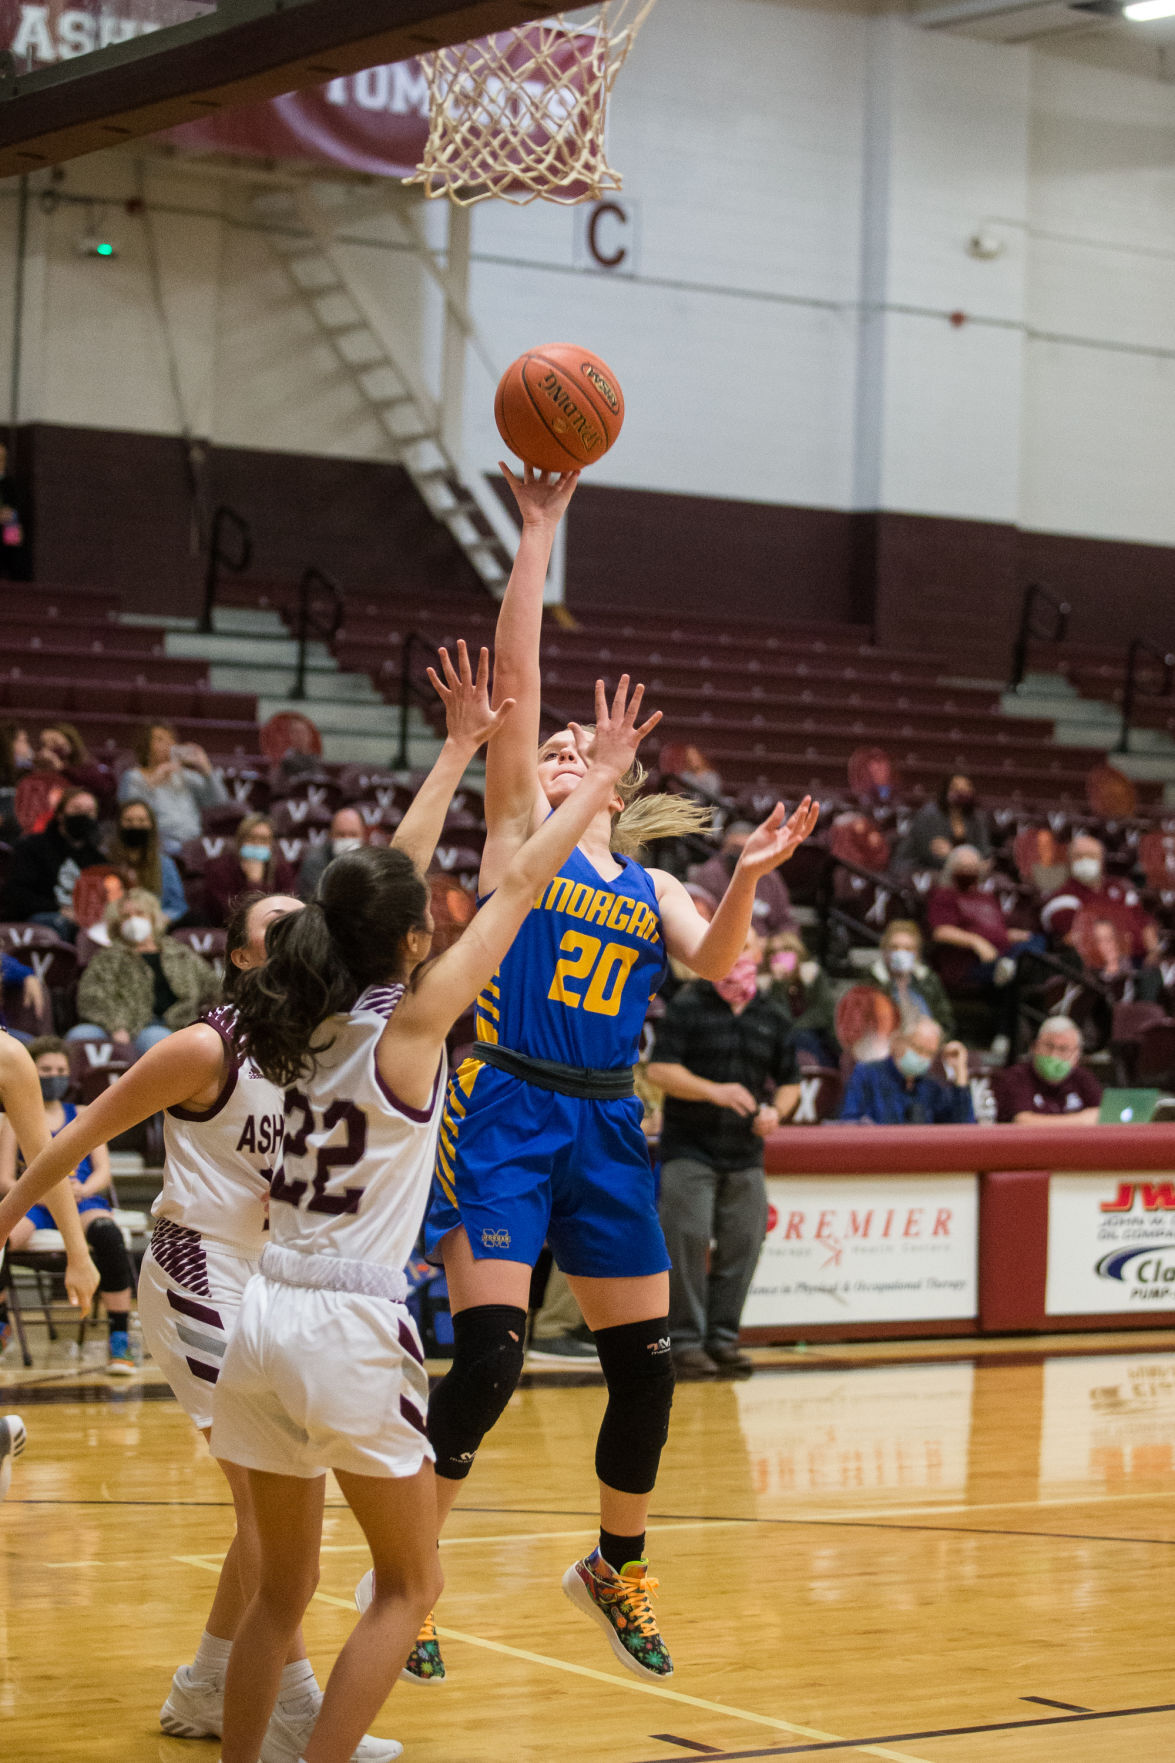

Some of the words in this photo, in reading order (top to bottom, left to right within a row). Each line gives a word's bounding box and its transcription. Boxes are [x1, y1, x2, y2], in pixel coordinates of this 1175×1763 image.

[12, 5, 161, 63] ASH
[588, 202, 627, 268] C
[538, 370, 604, 452] SPALDING
[533, 876, 660, 944] MORGAN
[547, 929, 640, 1017] 20
[236, 1113, 284, 1154] ASH
[269, 1086, 368, 1214] 22
